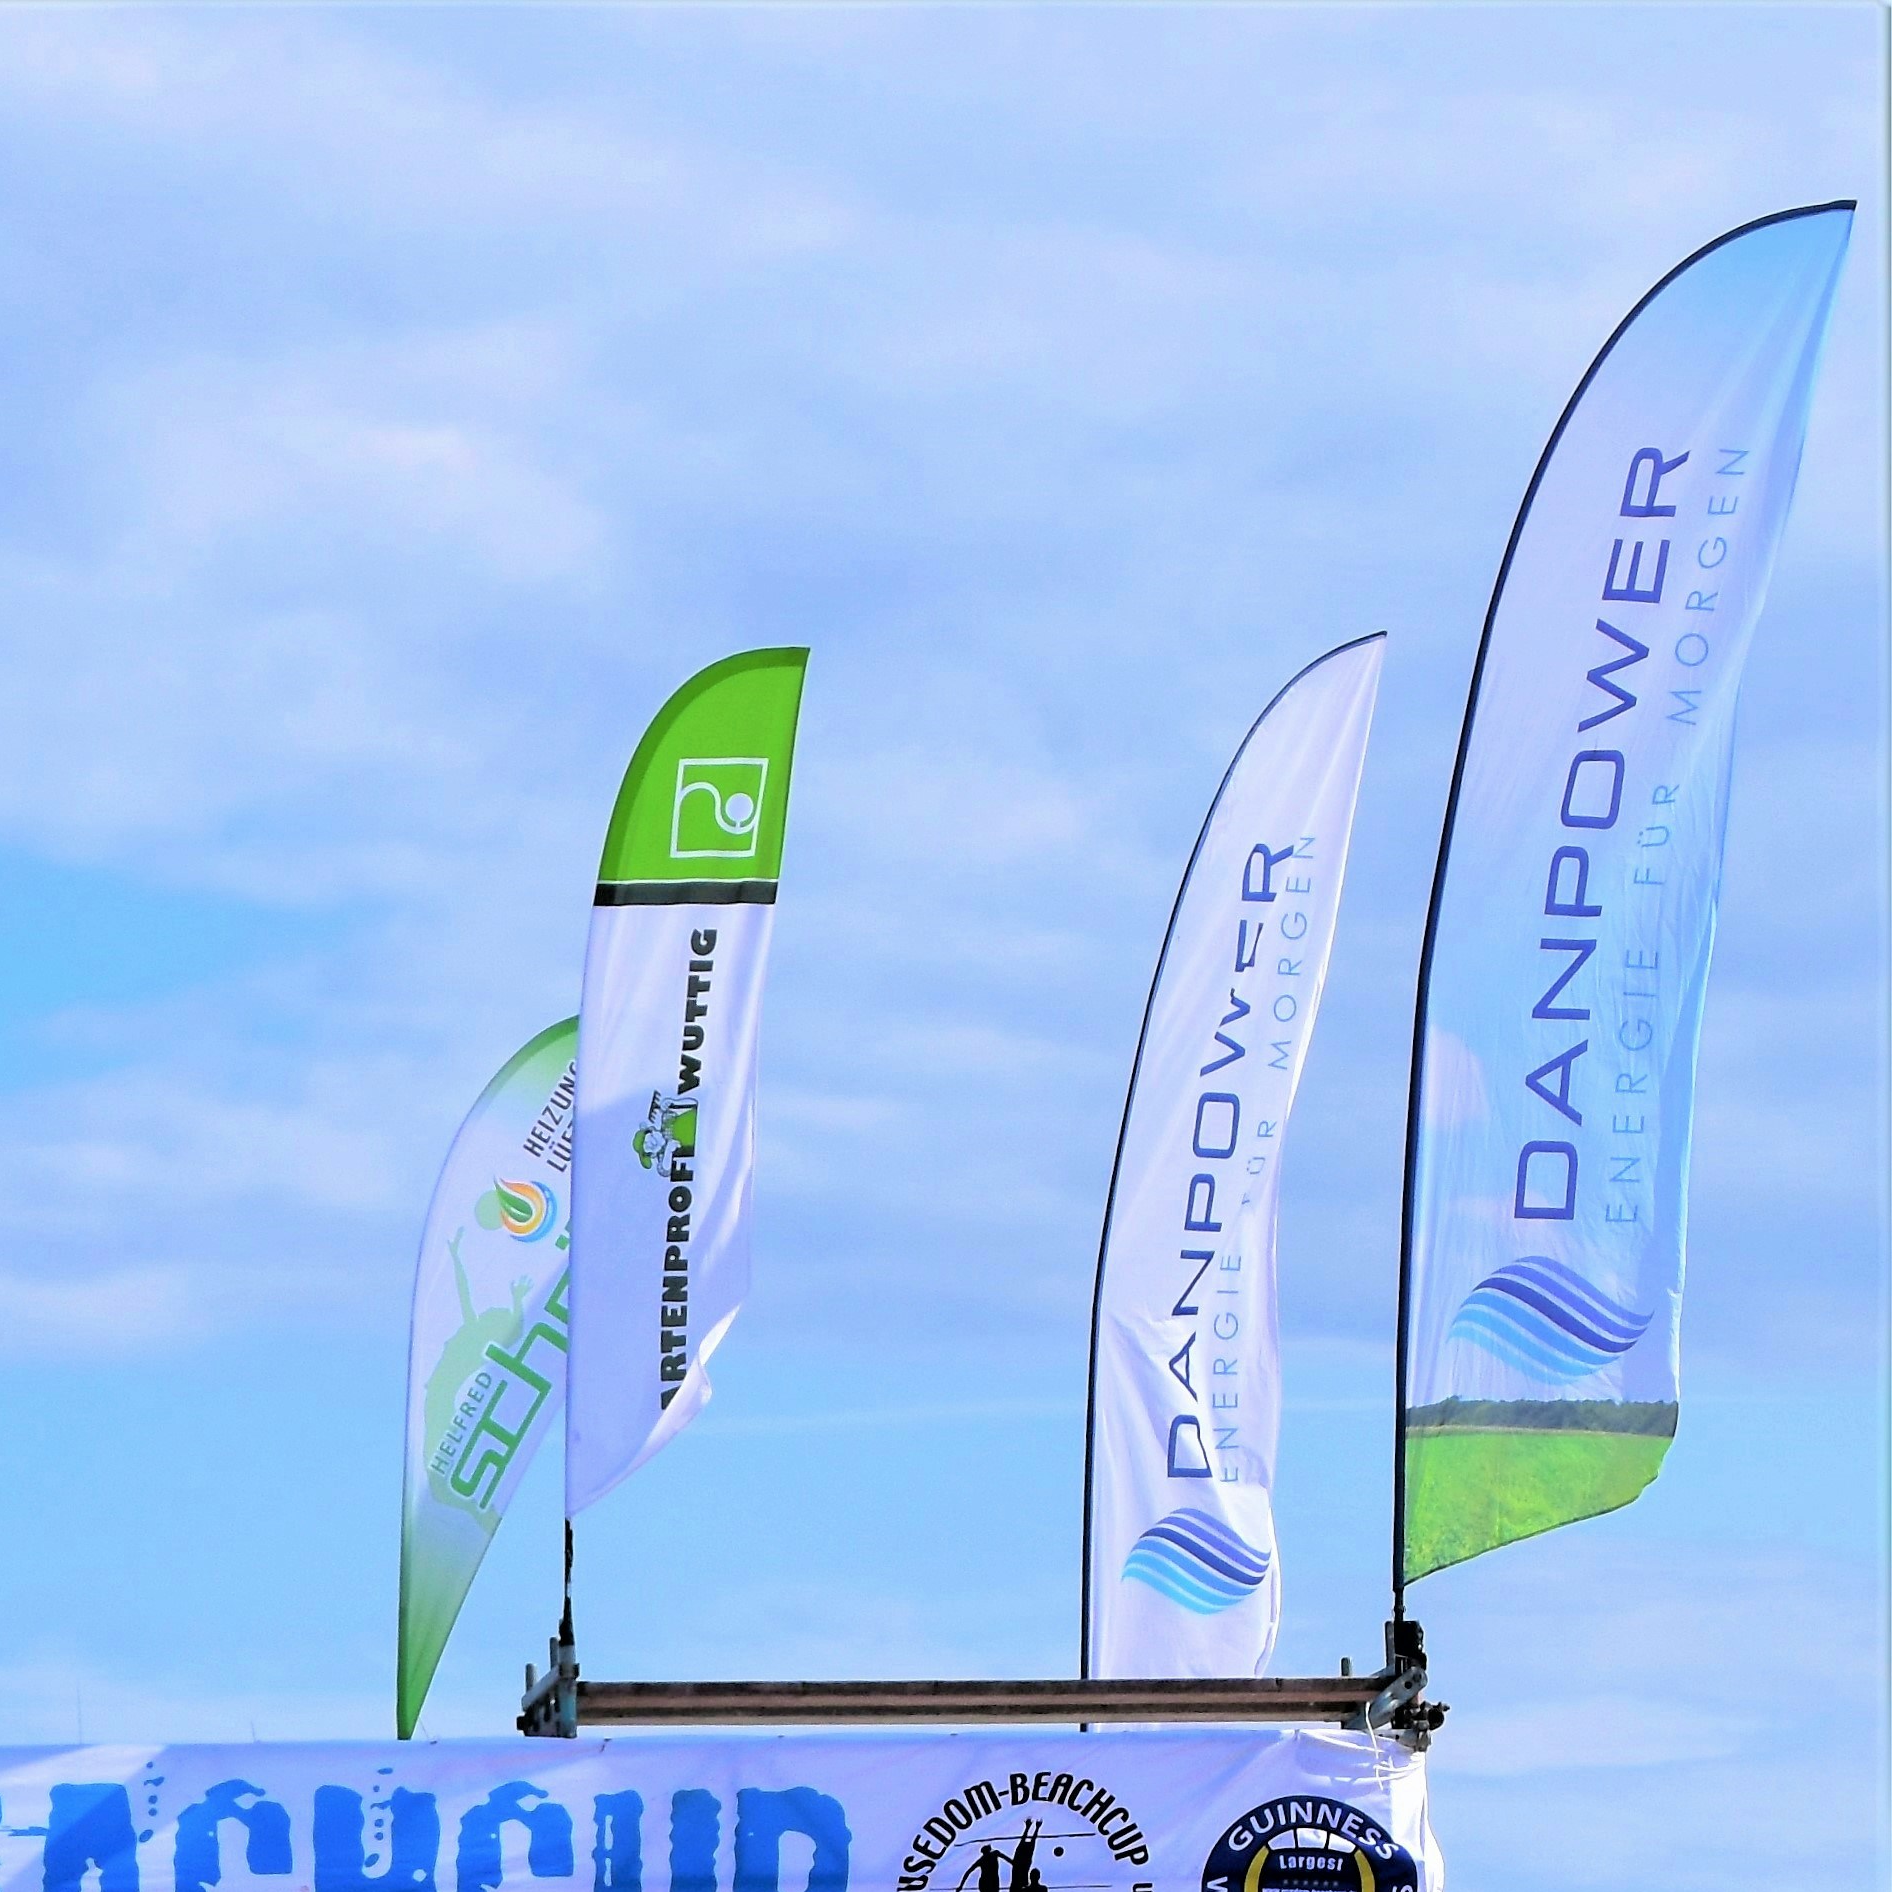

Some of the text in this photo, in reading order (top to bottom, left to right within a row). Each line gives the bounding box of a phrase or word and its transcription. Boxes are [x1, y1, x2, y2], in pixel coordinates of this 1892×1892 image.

[1514, 446, 1690, 1220] DANPOWER
[1605, 448, 1749, 1224] ENERGIE FÜR MORGEN
[661, 928, 718, 1410] ARTENPROFI WUTTIG
[1167, 842, 1294, 1478] DANPOWER
[1212, 1254, 1243, 1484] ENERGIE
[1267, 836, 1316, 1071] MORGEN
[429, 1372, 493, 1475] HELFRED
[896, 1771, 1150, 1892] USEDOM-BEACHCUP
[1228, 1801, 1400, 1863] GUINNESS
[1279, 1854, 1344, 1872] Largest
